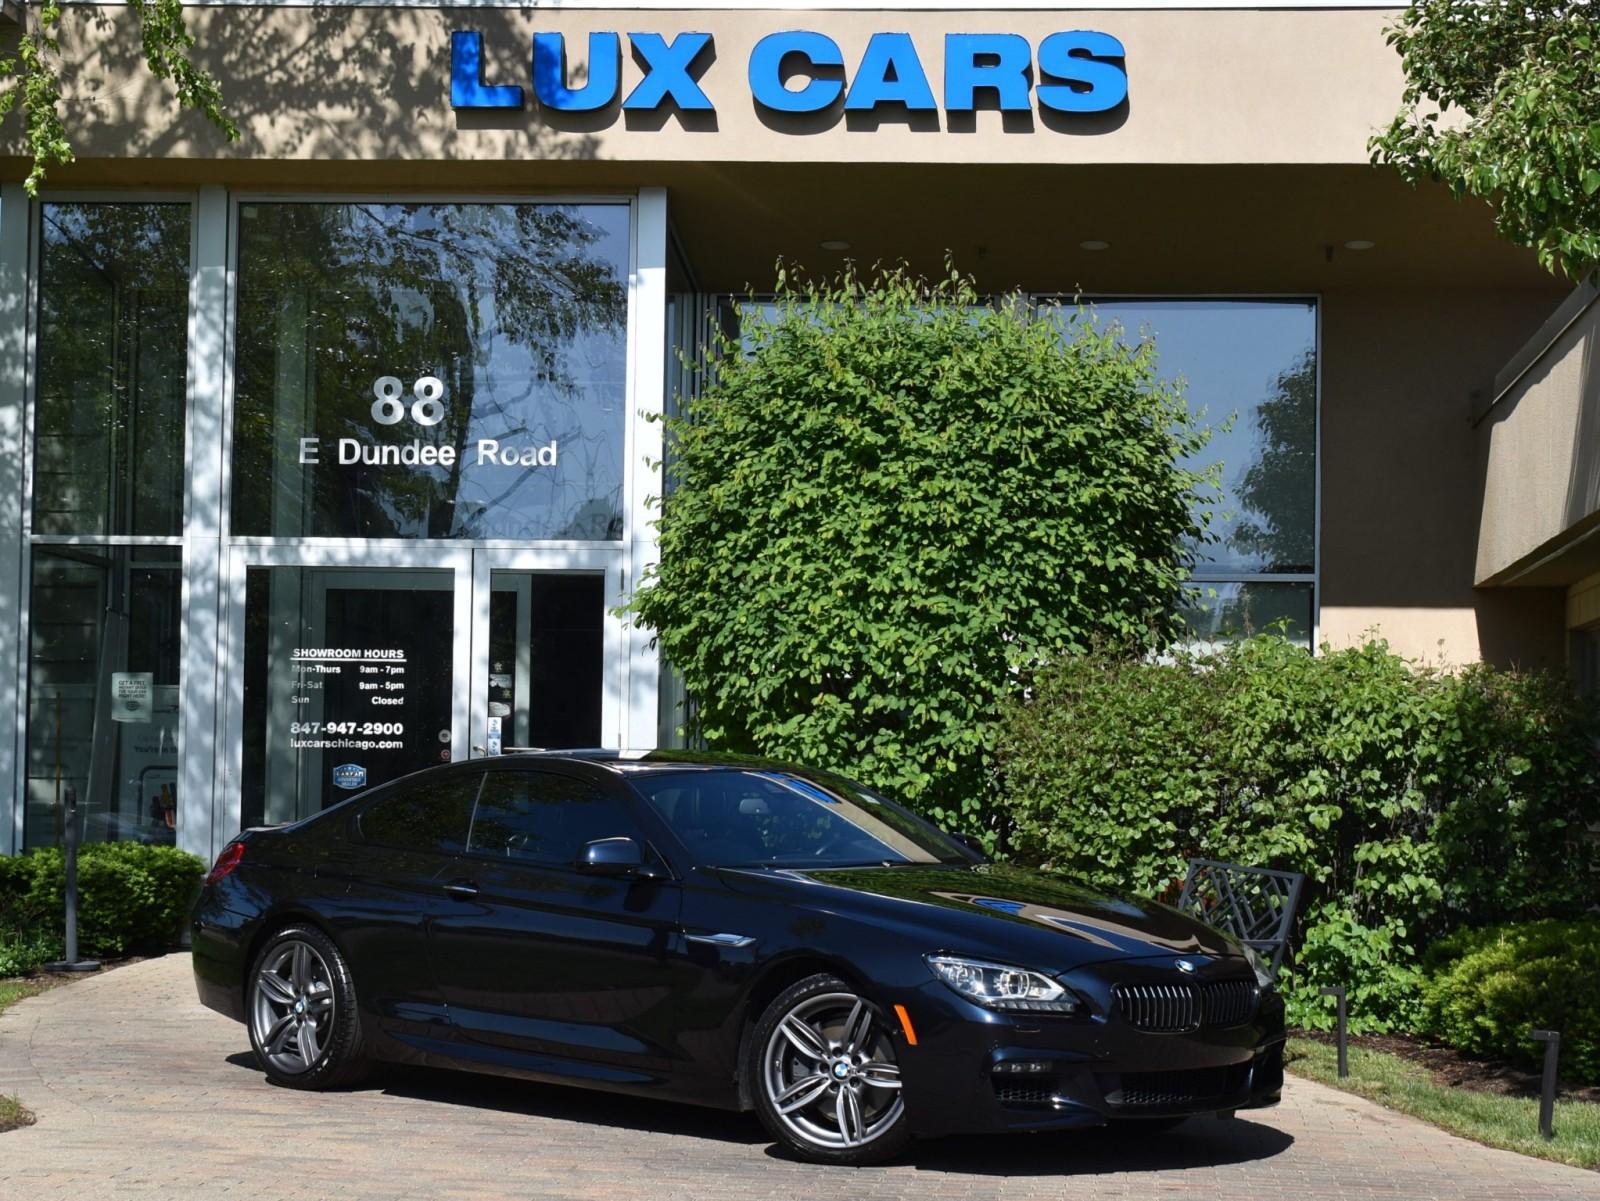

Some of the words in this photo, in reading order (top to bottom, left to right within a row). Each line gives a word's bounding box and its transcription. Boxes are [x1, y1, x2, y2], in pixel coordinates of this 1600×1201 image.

[450, 30, 717, 111] LUX
[747, 29, 1128, 112] CARS
[370, 375, 445, 426] 88
[298, 437, 319, 464] E
[338, 438, 456, 466] Dundee
[477, 438, 557, 466] Road
[293, 648, 361, 658] SHOWROOM
[364, 649, 404, 659] HOURS
[291, 664, 341, 673] Mon-Thurs
[359, 665, 378, 674] 9am
[385, 666, 404, 675] 7pm
[291, 680, 323, 689] Fri-Sat
[358, 681, 378, 689] 9am
[385, 681, 404, 691] 5pm
[291, 695, 310, 704] Sun
[371, 696, 404, 705] Closed
[290, 722, 404, 735] 847-947-2900
[290, 738, 403, 750] luxcarschicago.com
